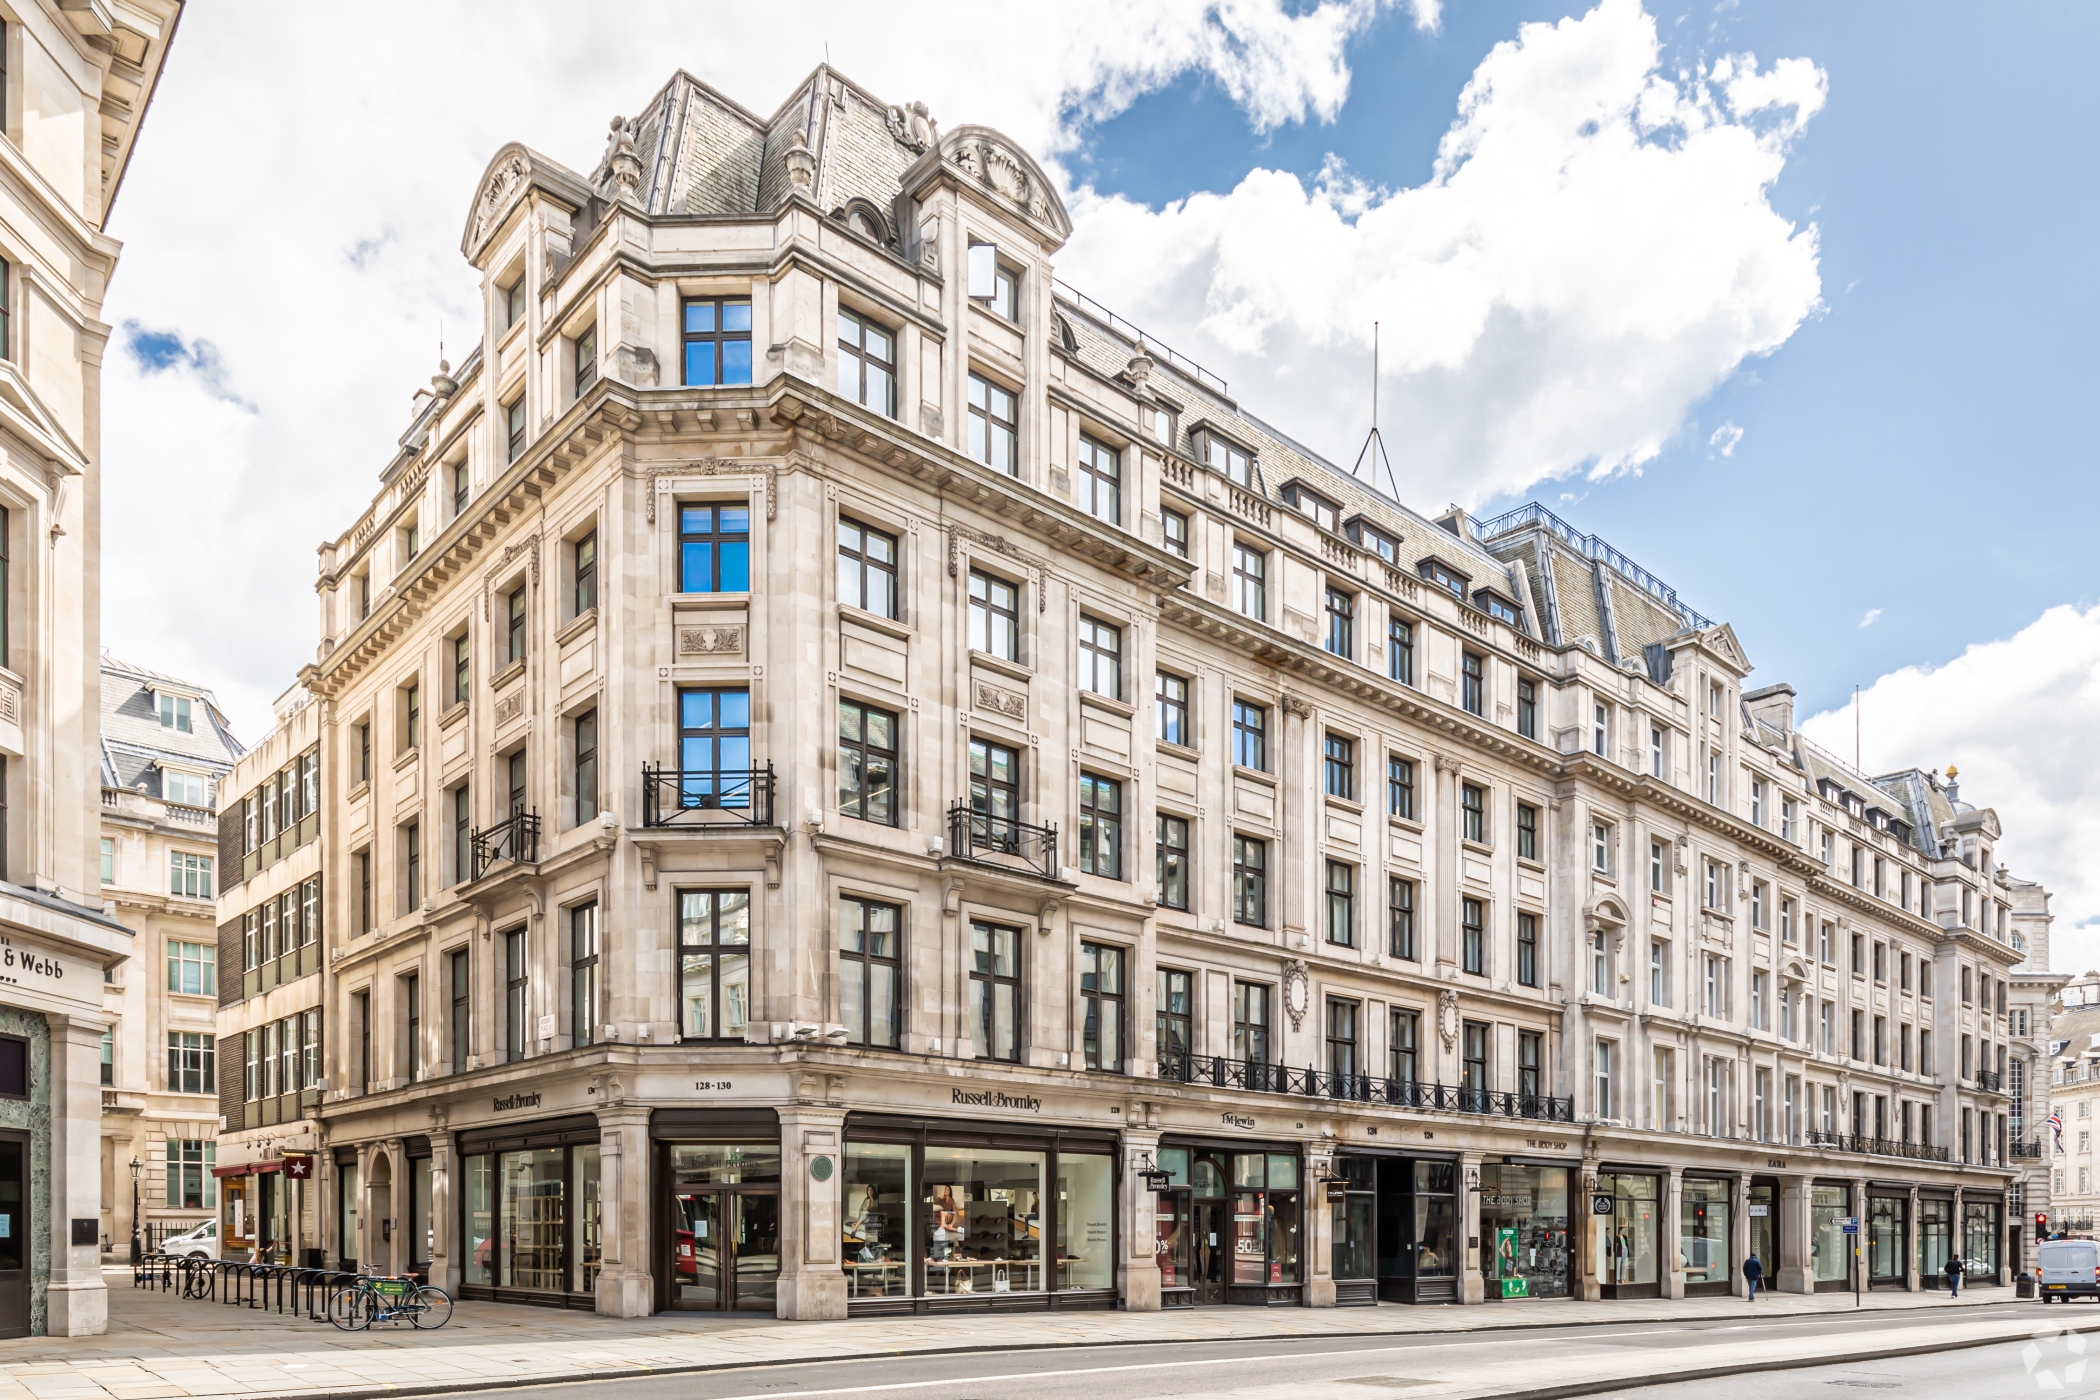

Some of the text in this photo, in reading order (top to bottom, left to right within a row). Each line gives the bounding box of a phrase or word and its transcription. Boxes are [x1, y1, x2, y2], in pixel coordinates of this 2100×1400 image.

[4, 948, 63, 979] & Webb
[1367, 1127, 1377, 1135] 124
[1424, 1131, 1433, 1139] 124
[1526, 1139, 1537, 1148] THE
[1538, 1140, 1553, 1149] BODY
[1768, 1160, 1786, 1168] ZARA
[1482, 1195, 1497, 1204] THE
[1515, 1196, 1532, 1205] SHOP
